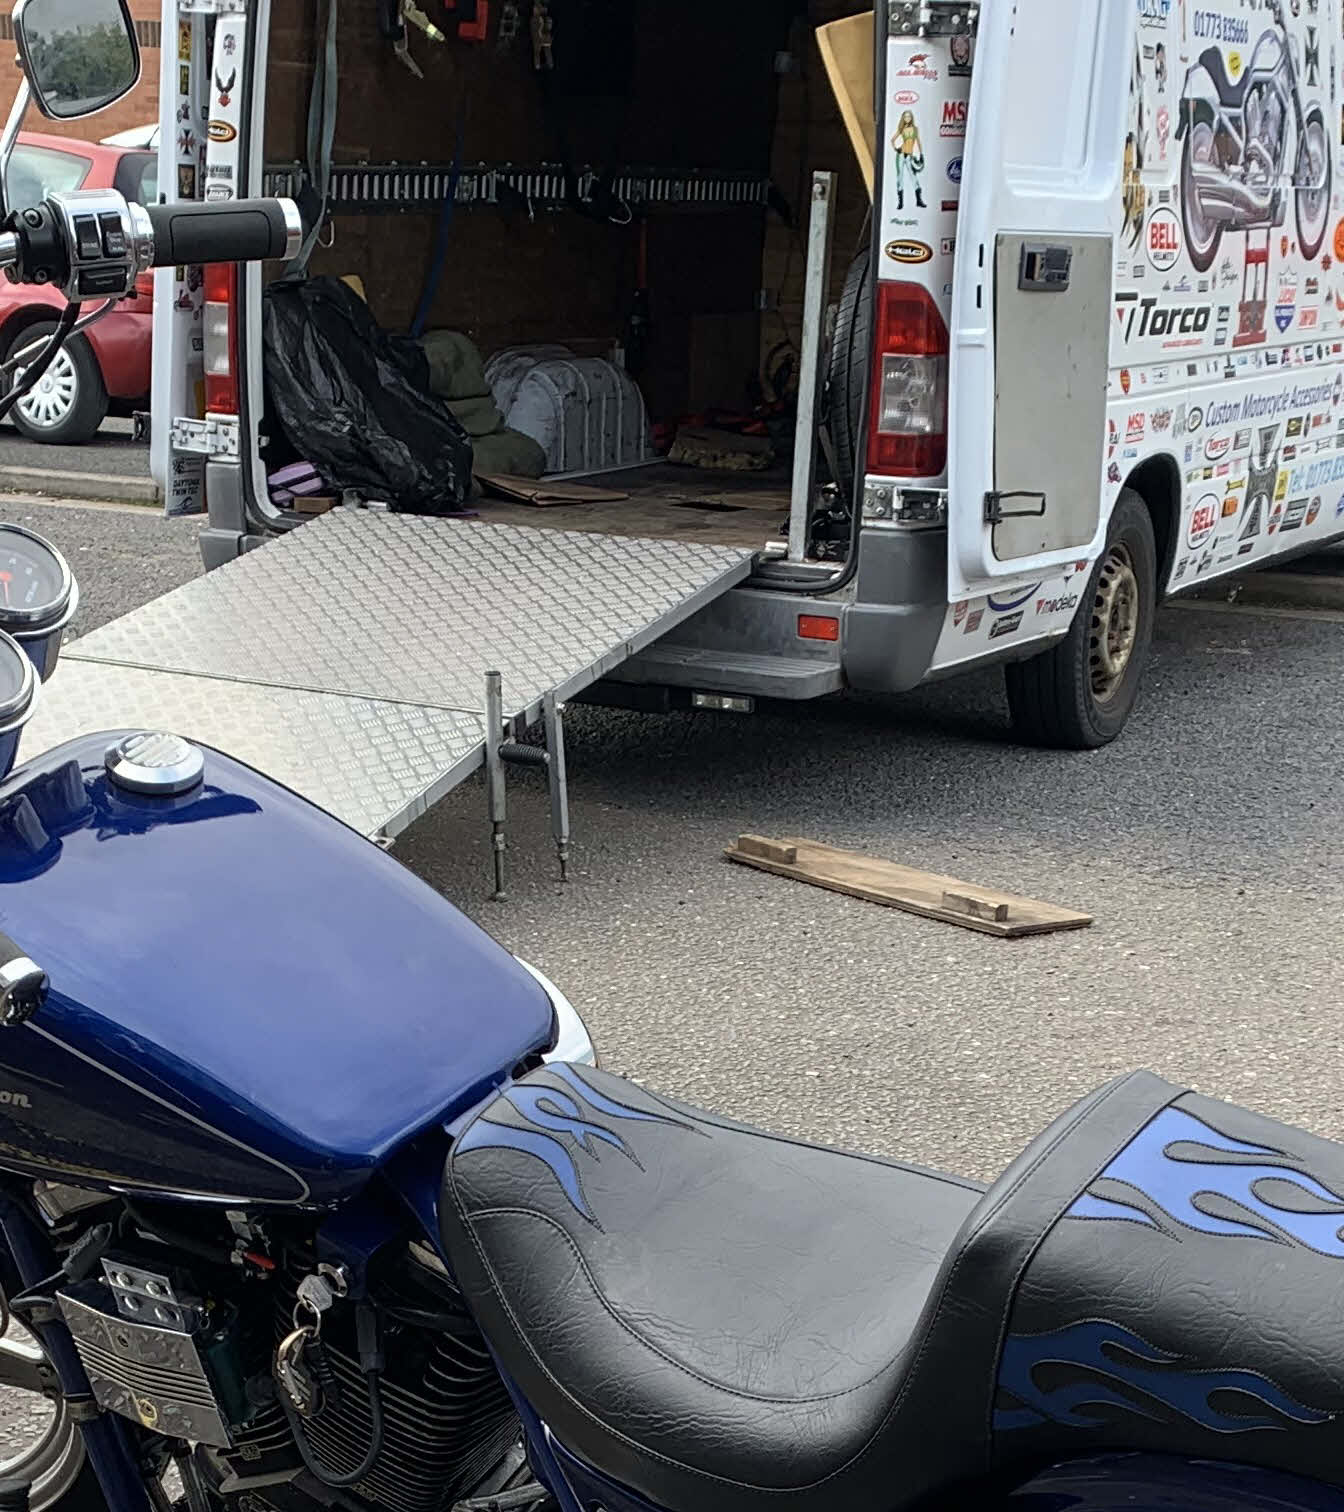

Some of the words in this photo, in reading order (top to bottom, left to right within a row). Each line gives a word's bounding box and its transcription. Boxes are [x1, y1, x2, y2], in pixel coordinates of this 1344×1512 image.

[1194, 10, 1221, 39] 01773
[942, 101, 967, 122] MS
[1150, 222, 1179, 250] BELL
[1138, 297, 1211, 337] Torco
[1205, 401, 1241, 428] Custom
[1241, 386, 1289, 420] Motorcycle
[1290, 380, 1333, 408] Accessories
[1191, 504, 1216, 535] BELL
